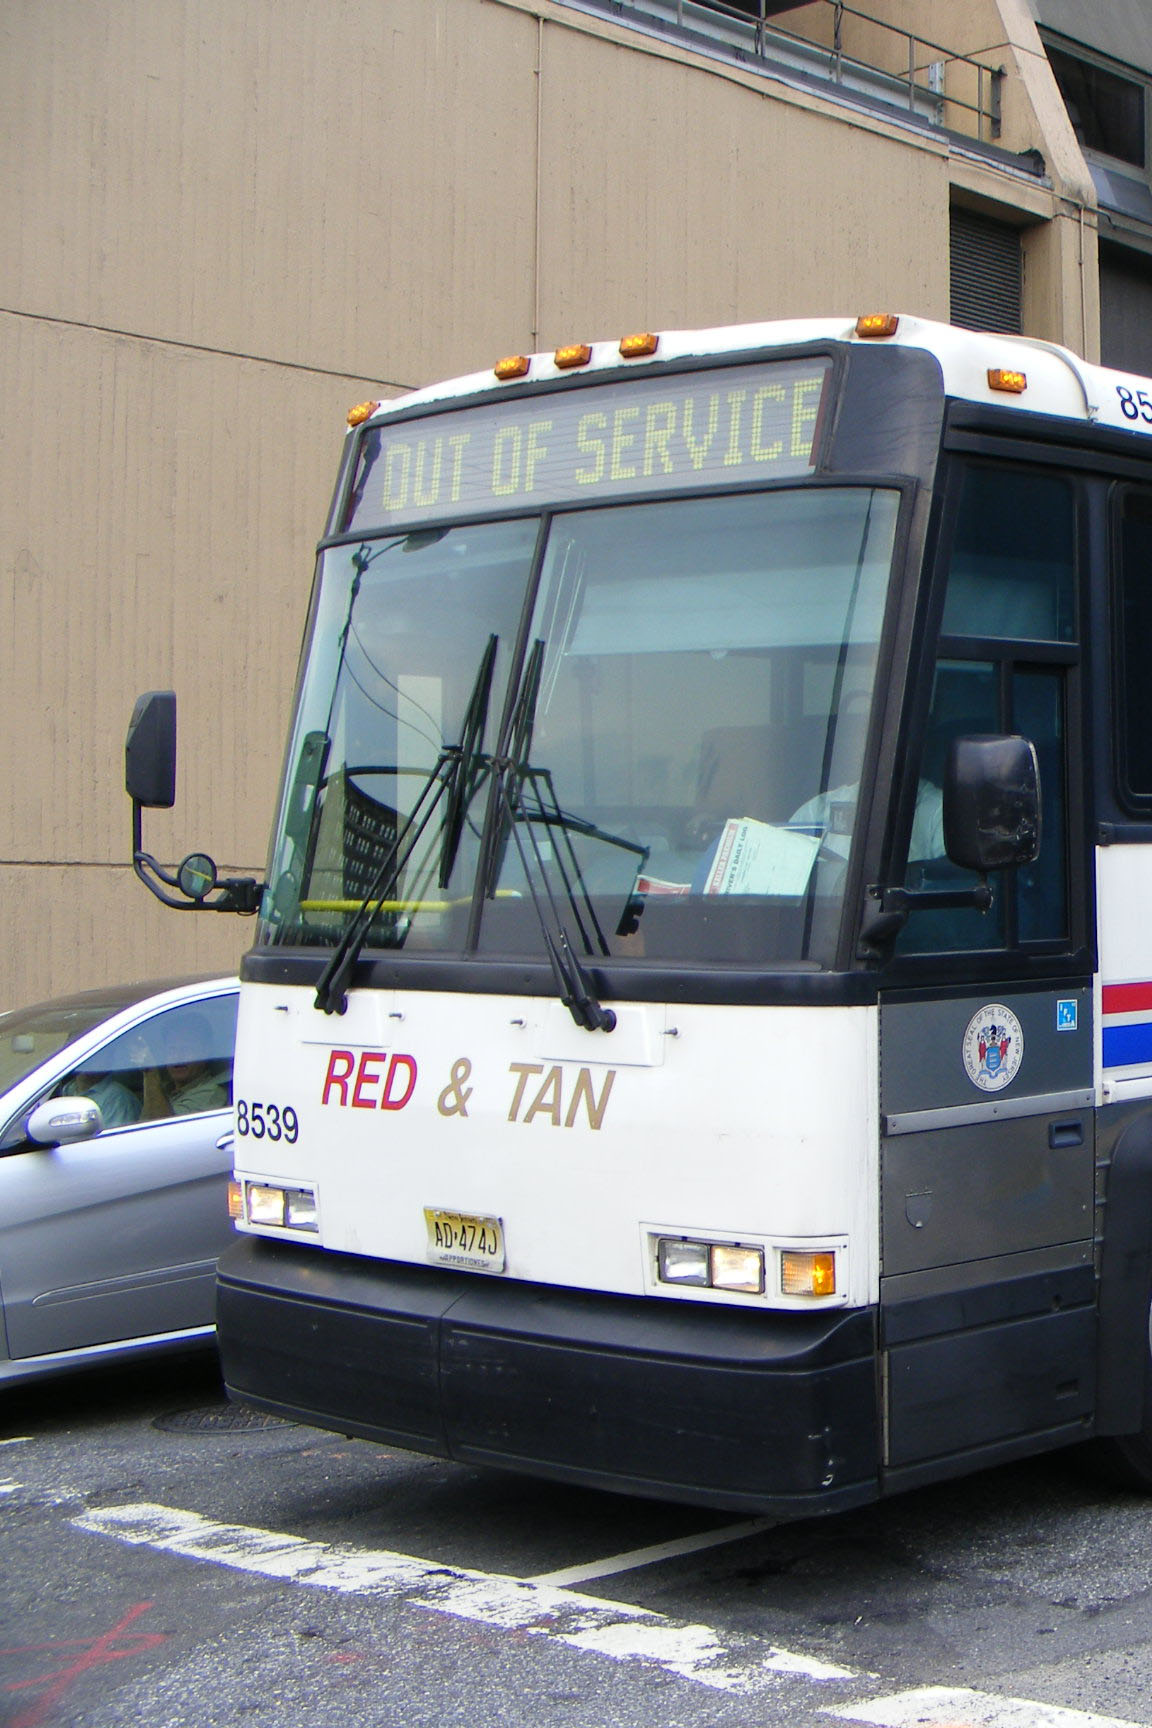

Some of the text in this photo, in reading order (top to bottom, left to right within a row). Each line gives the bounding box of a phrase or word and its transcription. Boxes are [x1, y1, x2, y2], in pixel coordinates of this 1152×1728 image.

[383, 376, 825, 511] OUT OF SERVICE
[237, 1100, 299, 1144] 8539
[321, 1050, 616, 1130] RED & TAN
